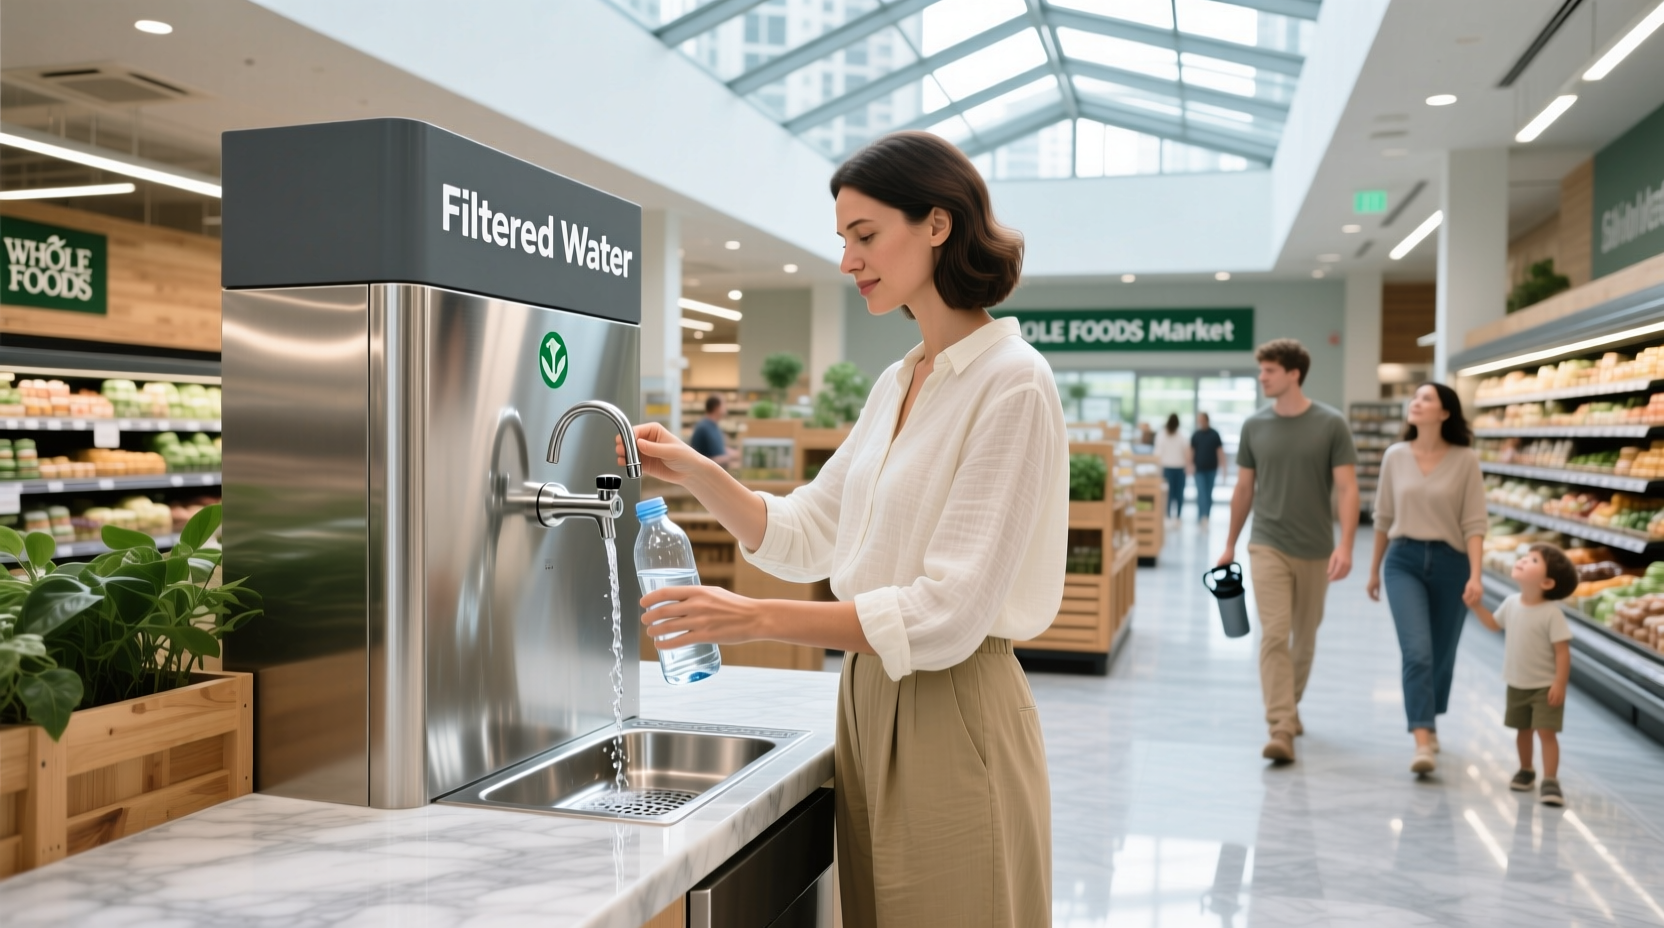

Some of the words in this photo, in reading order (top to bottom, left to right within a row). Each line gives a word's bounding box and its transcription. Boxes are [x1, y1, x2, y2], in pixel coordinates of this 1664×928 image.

[442, 183, 554, 258] Filtered
[560, 220, 633, 278] Water
[3, 235, 93, 275] WHOLE
[8, 264, 93, 301] FOODS
[1020, 319, 1066, 344] OLE
[1068, 318, 1145, 343] FOODS
[1148, 317, 1235, 342] Market
